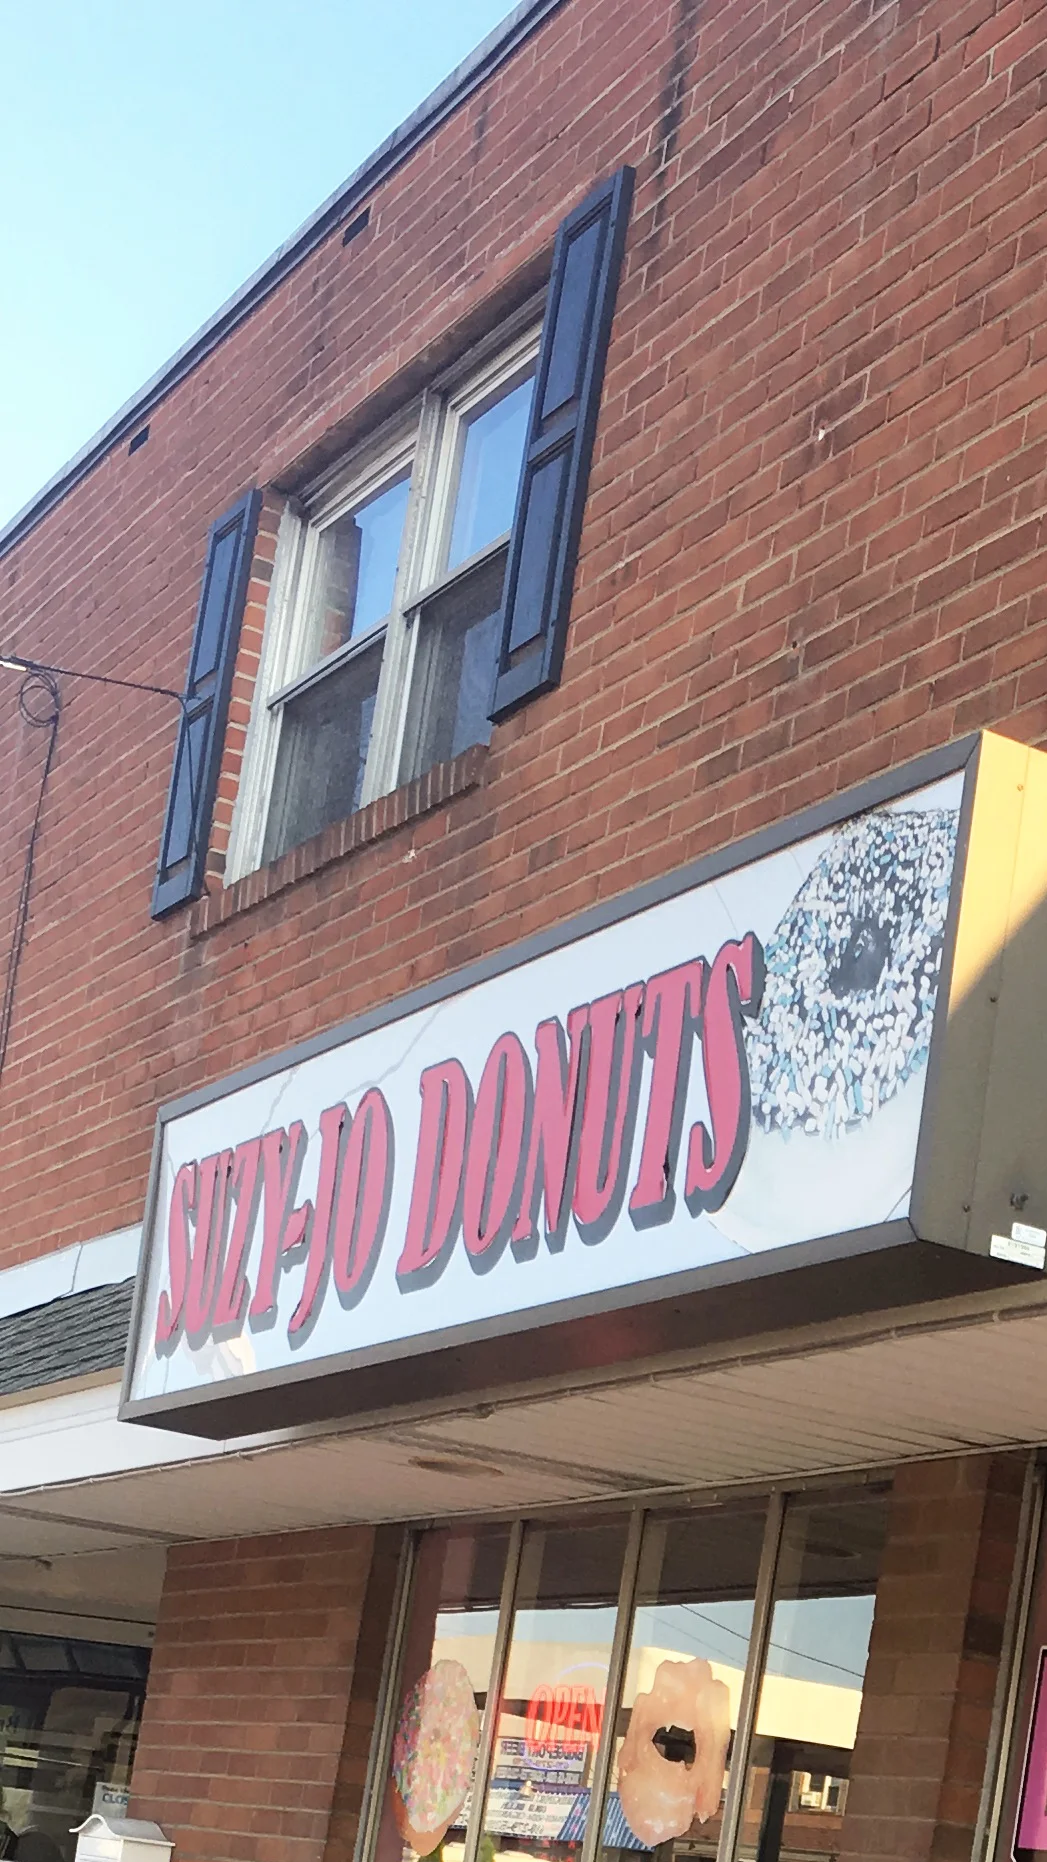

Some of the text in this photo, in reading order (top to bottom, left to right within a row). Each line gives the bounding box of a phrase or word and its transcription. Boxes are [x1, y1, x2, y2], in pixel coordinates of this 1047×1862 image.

[156, 932, 763, 1346] SUZY-JO DONUTS
[525, 1684, 606, 1752] OPEN
[102, 1793, 129, 1806] CLOS
